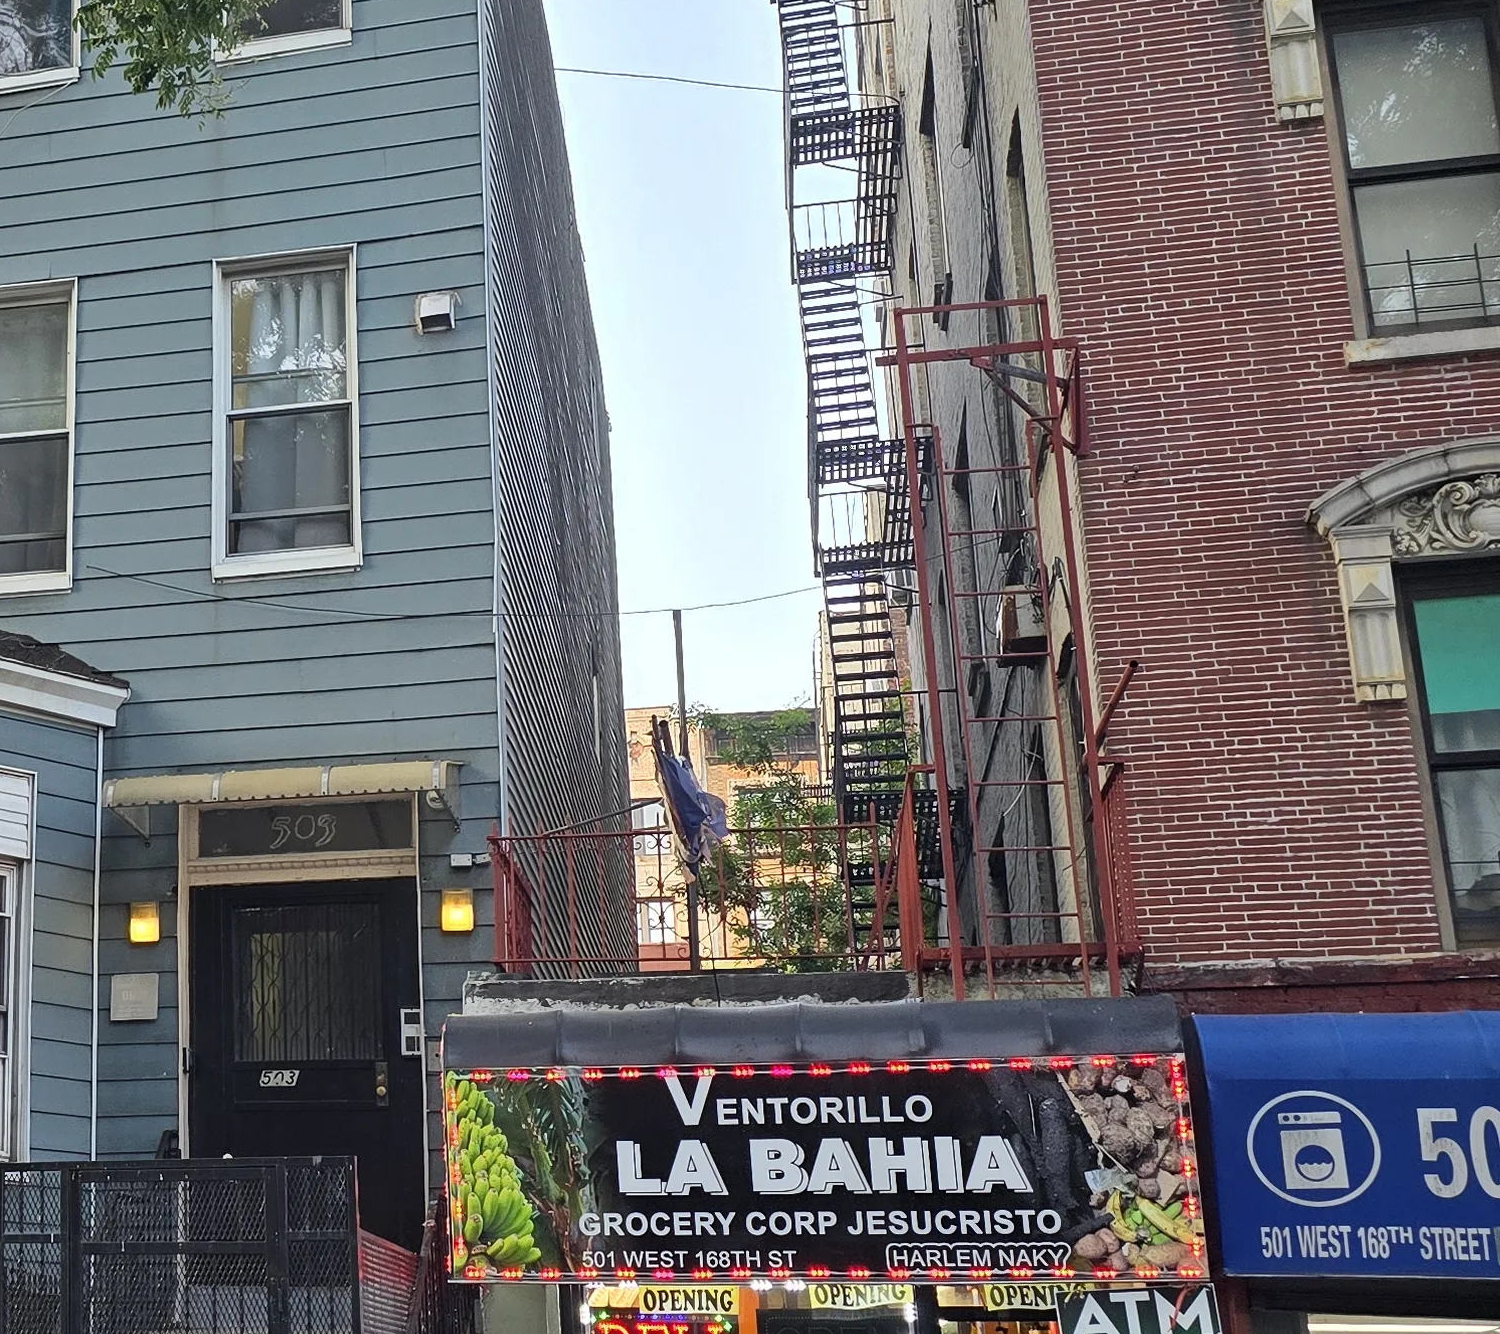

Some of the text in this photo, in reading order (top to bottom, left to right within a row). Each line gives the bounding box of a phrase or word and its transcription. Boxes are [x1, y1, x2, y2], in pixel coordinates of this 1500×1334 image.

[269, 813, 337, 850] 503
[664, 1073, 934, 1126] VENTORILLO
[616, 1135, 1034, 1196] LA BAHIA
[578, 1209, 1062, 1237] GROCERY CORP JESUCRISTO
[1260, 1225, 1491, 1261] 501 WEST 168TH STREET
[581, 1250, 798, 1269] 501 WEST 168TH ST
[893, 1249, 1064, 1267] HARLEM NAKY
[643, 1288, 734, 1312] OPENING
[814, 1284, 907, 1307] OPENING
